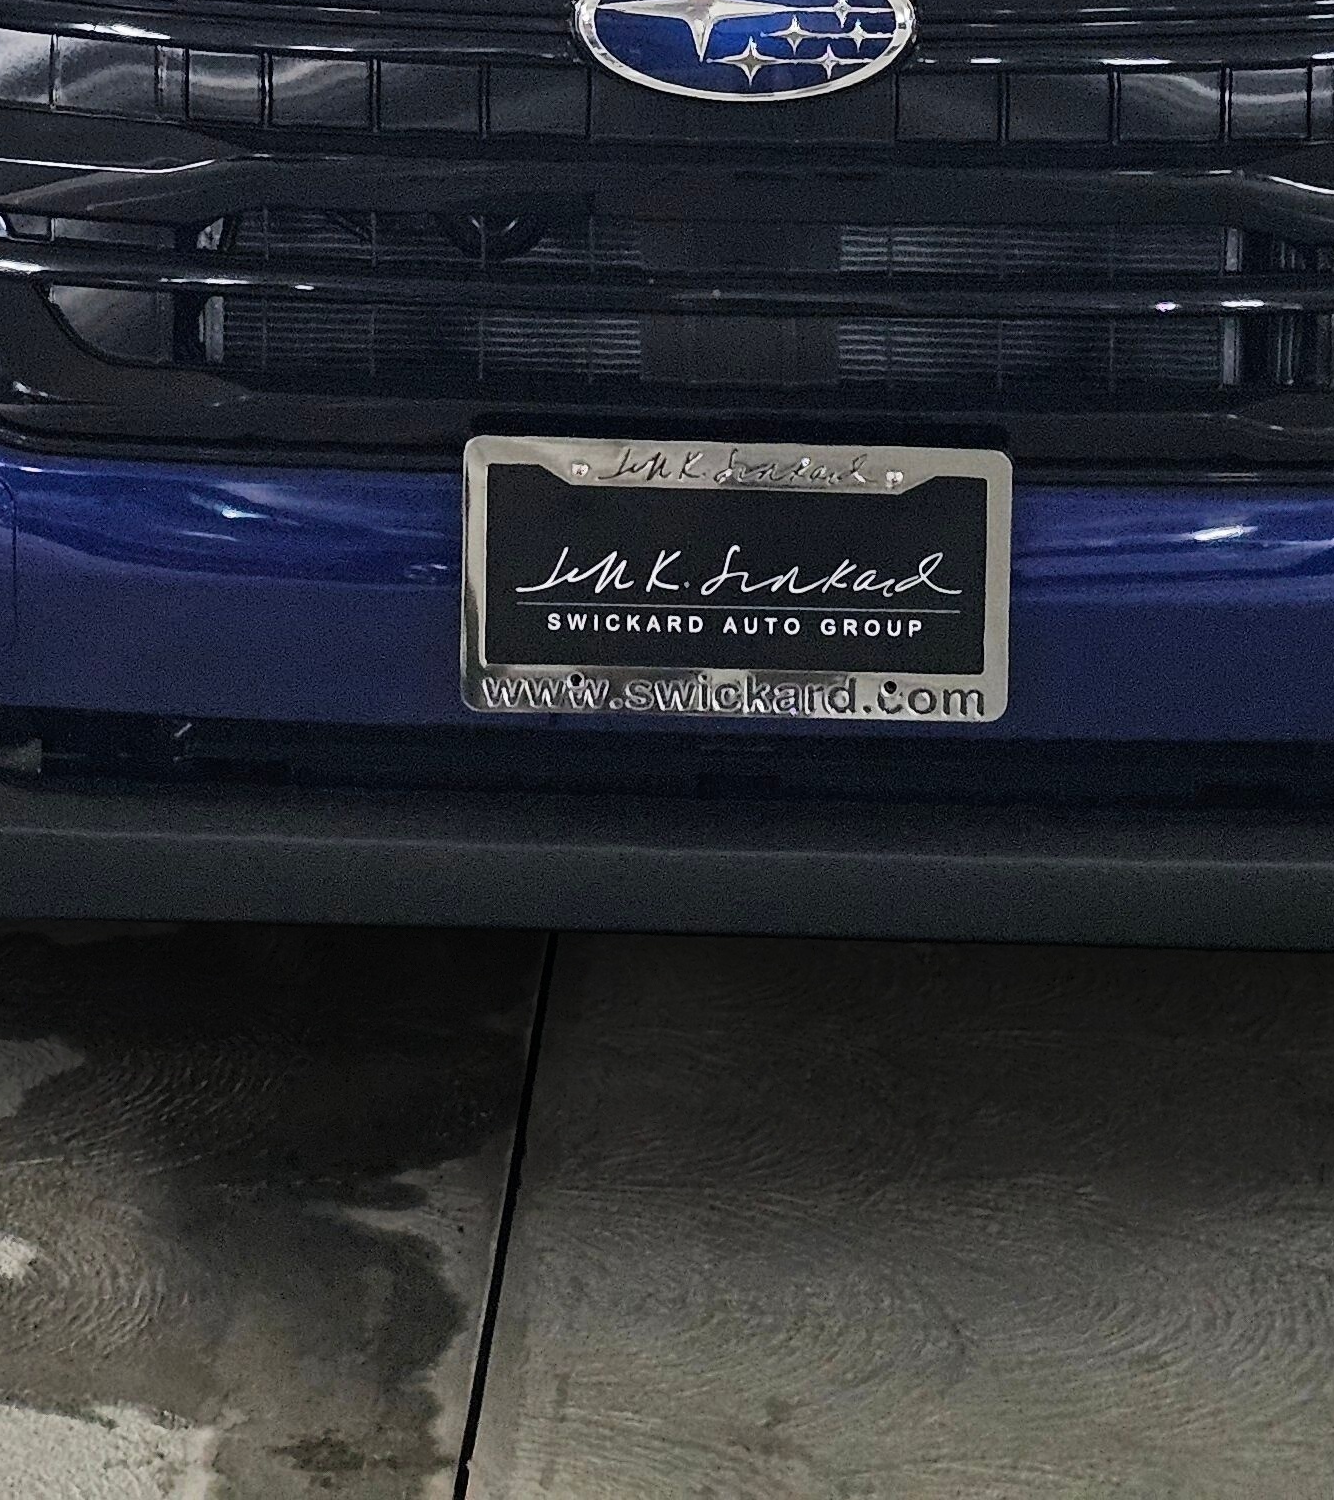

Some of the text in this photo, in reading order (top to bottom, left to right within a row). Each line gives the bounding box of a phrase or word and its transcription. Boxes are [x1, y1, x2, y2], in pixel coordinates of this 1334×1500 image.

[547, 612, 924, 638] SWICKARD AUTO GROUP
[481, 673, 986, 717] www.swickard.com
